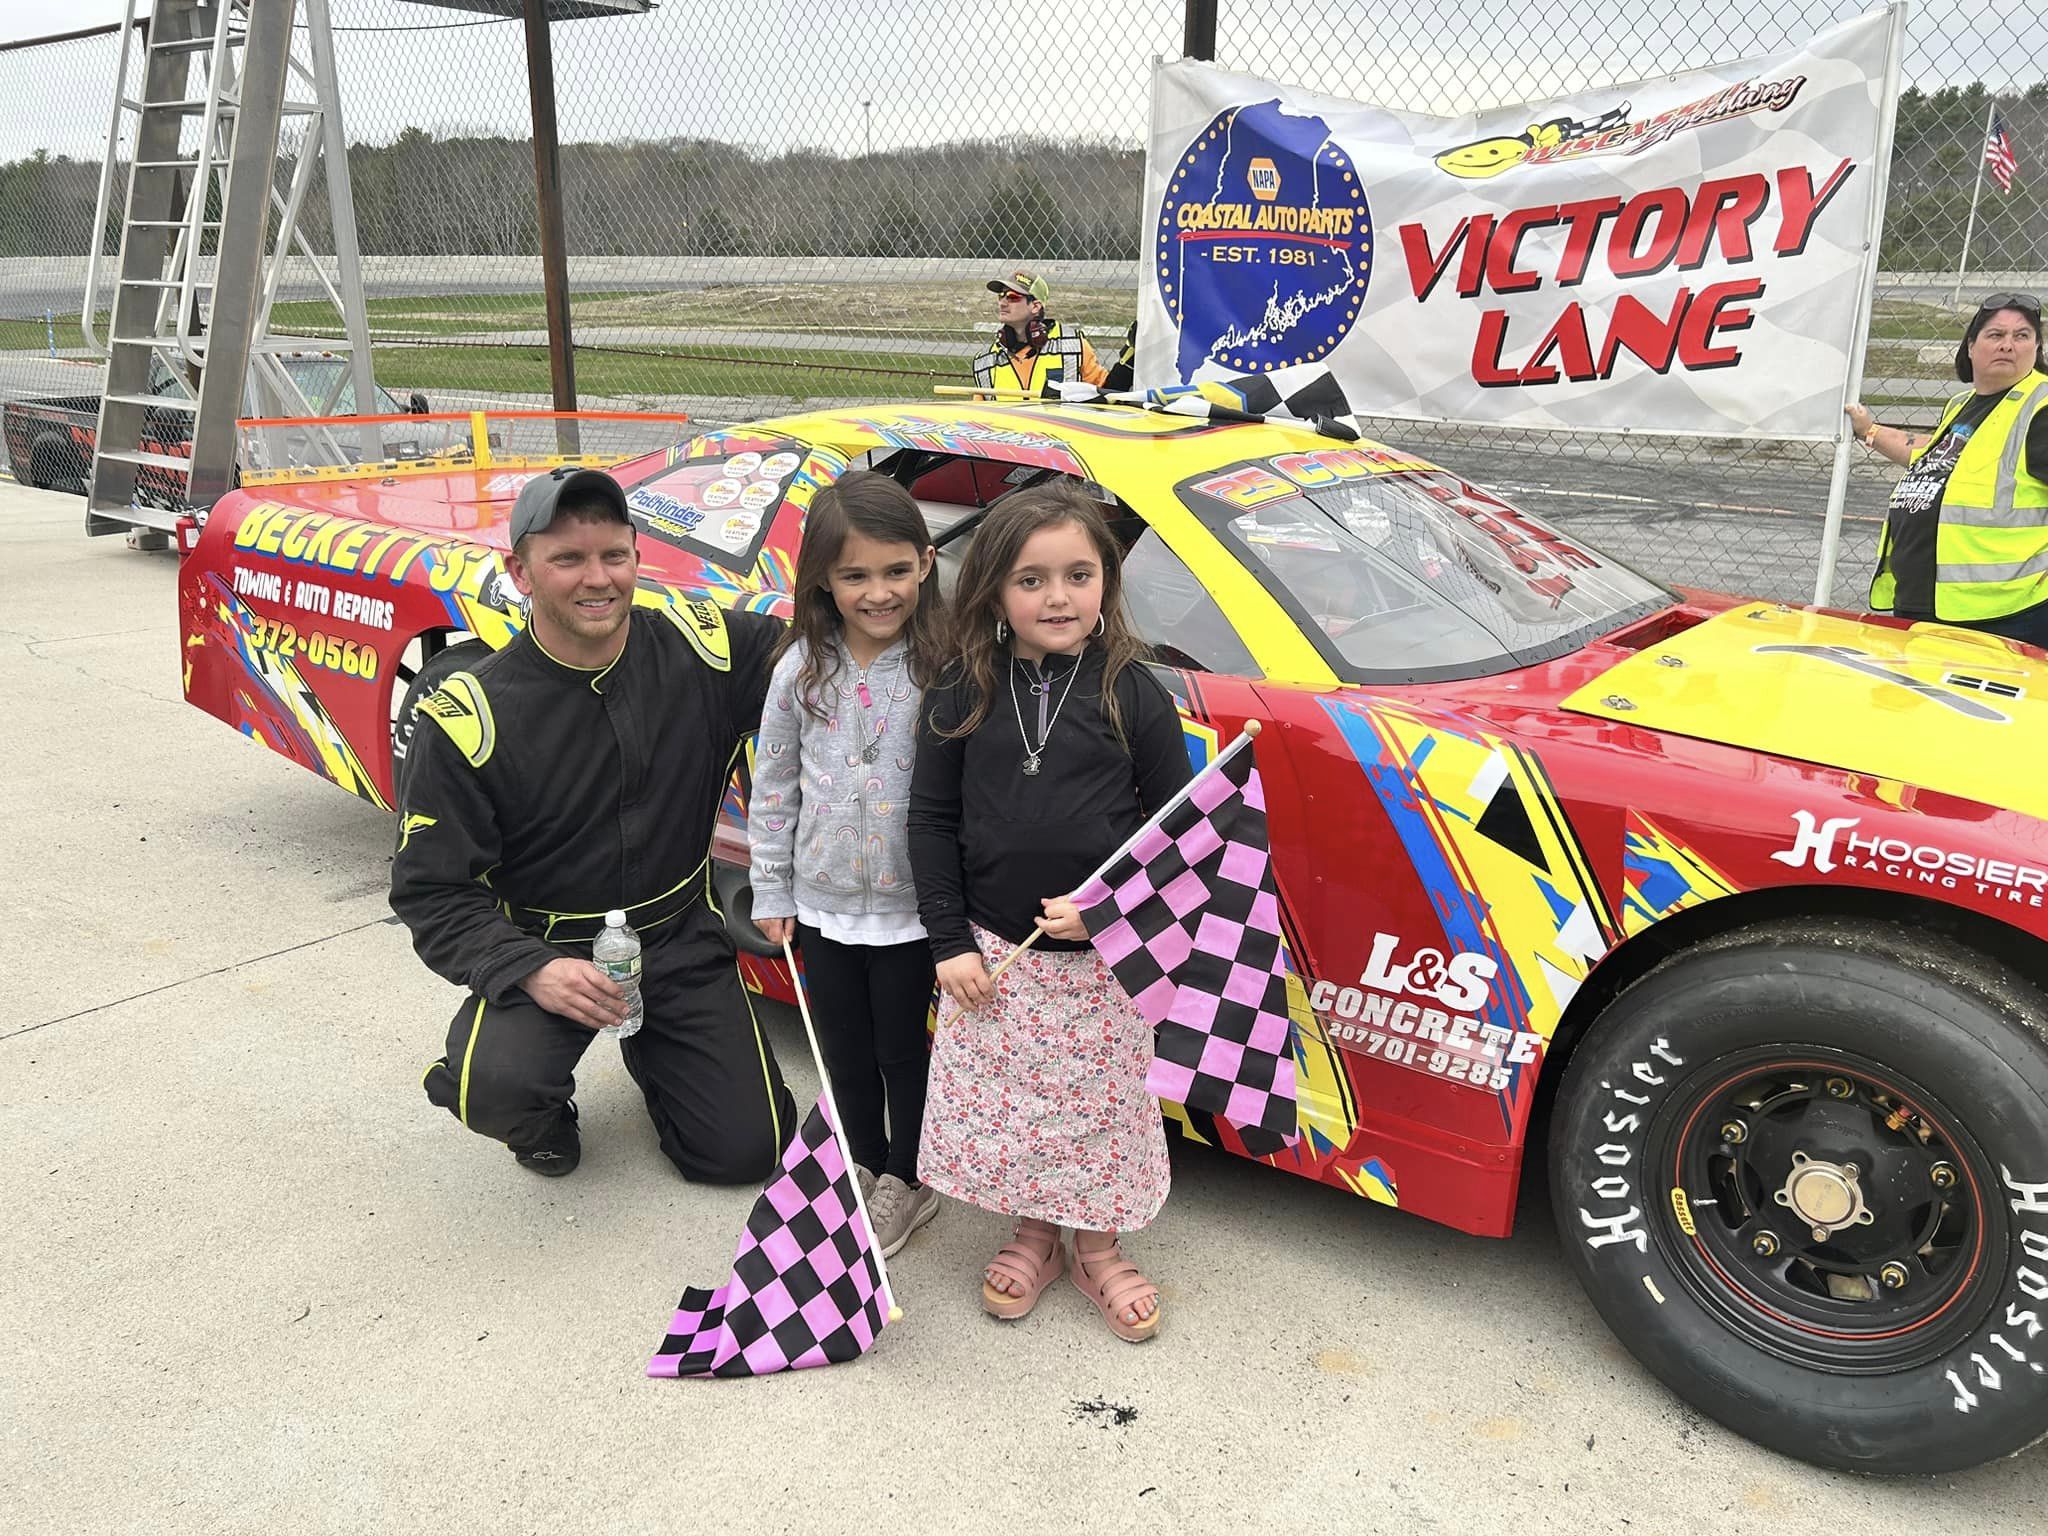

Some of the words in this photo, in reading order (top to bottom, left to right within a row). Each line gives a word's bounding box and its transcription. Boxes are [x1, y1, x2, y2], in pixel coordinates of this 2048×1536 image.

[1251, 169, 1276, 190] NAPA
[1176, 203, 1253, 230] COASTAL
[1254, 206, 1298, 232] AUTO
[1299, 208, 1354, 234] PARTS
[1399, 157, 1857, 302] VICTORY
[1212, 246, 1261, 264] EST.
[1268, 248, 1316, 266] 1981
[1470, 277, 1766, 387] LANE
[233, 566, 282, 602] TOWING
[284, 584, 293, 607] &
[294, 580, 330, 617] AUTO
[332, 593, 396, 632] REPAIRS
[1844, 854, 1956, 888] RACING
[1974, 882, 2043, 908] TIRE
[1847, 831, 2048, 894] HOOSIER
[1359, 931, 1499, 1012] L&S
[1309, 980, 1544, 1064] CONCRETE
[1579, 1036, 1685, 1254] Hoosier
[1674, 1193, 1694, 1231] Bassett
